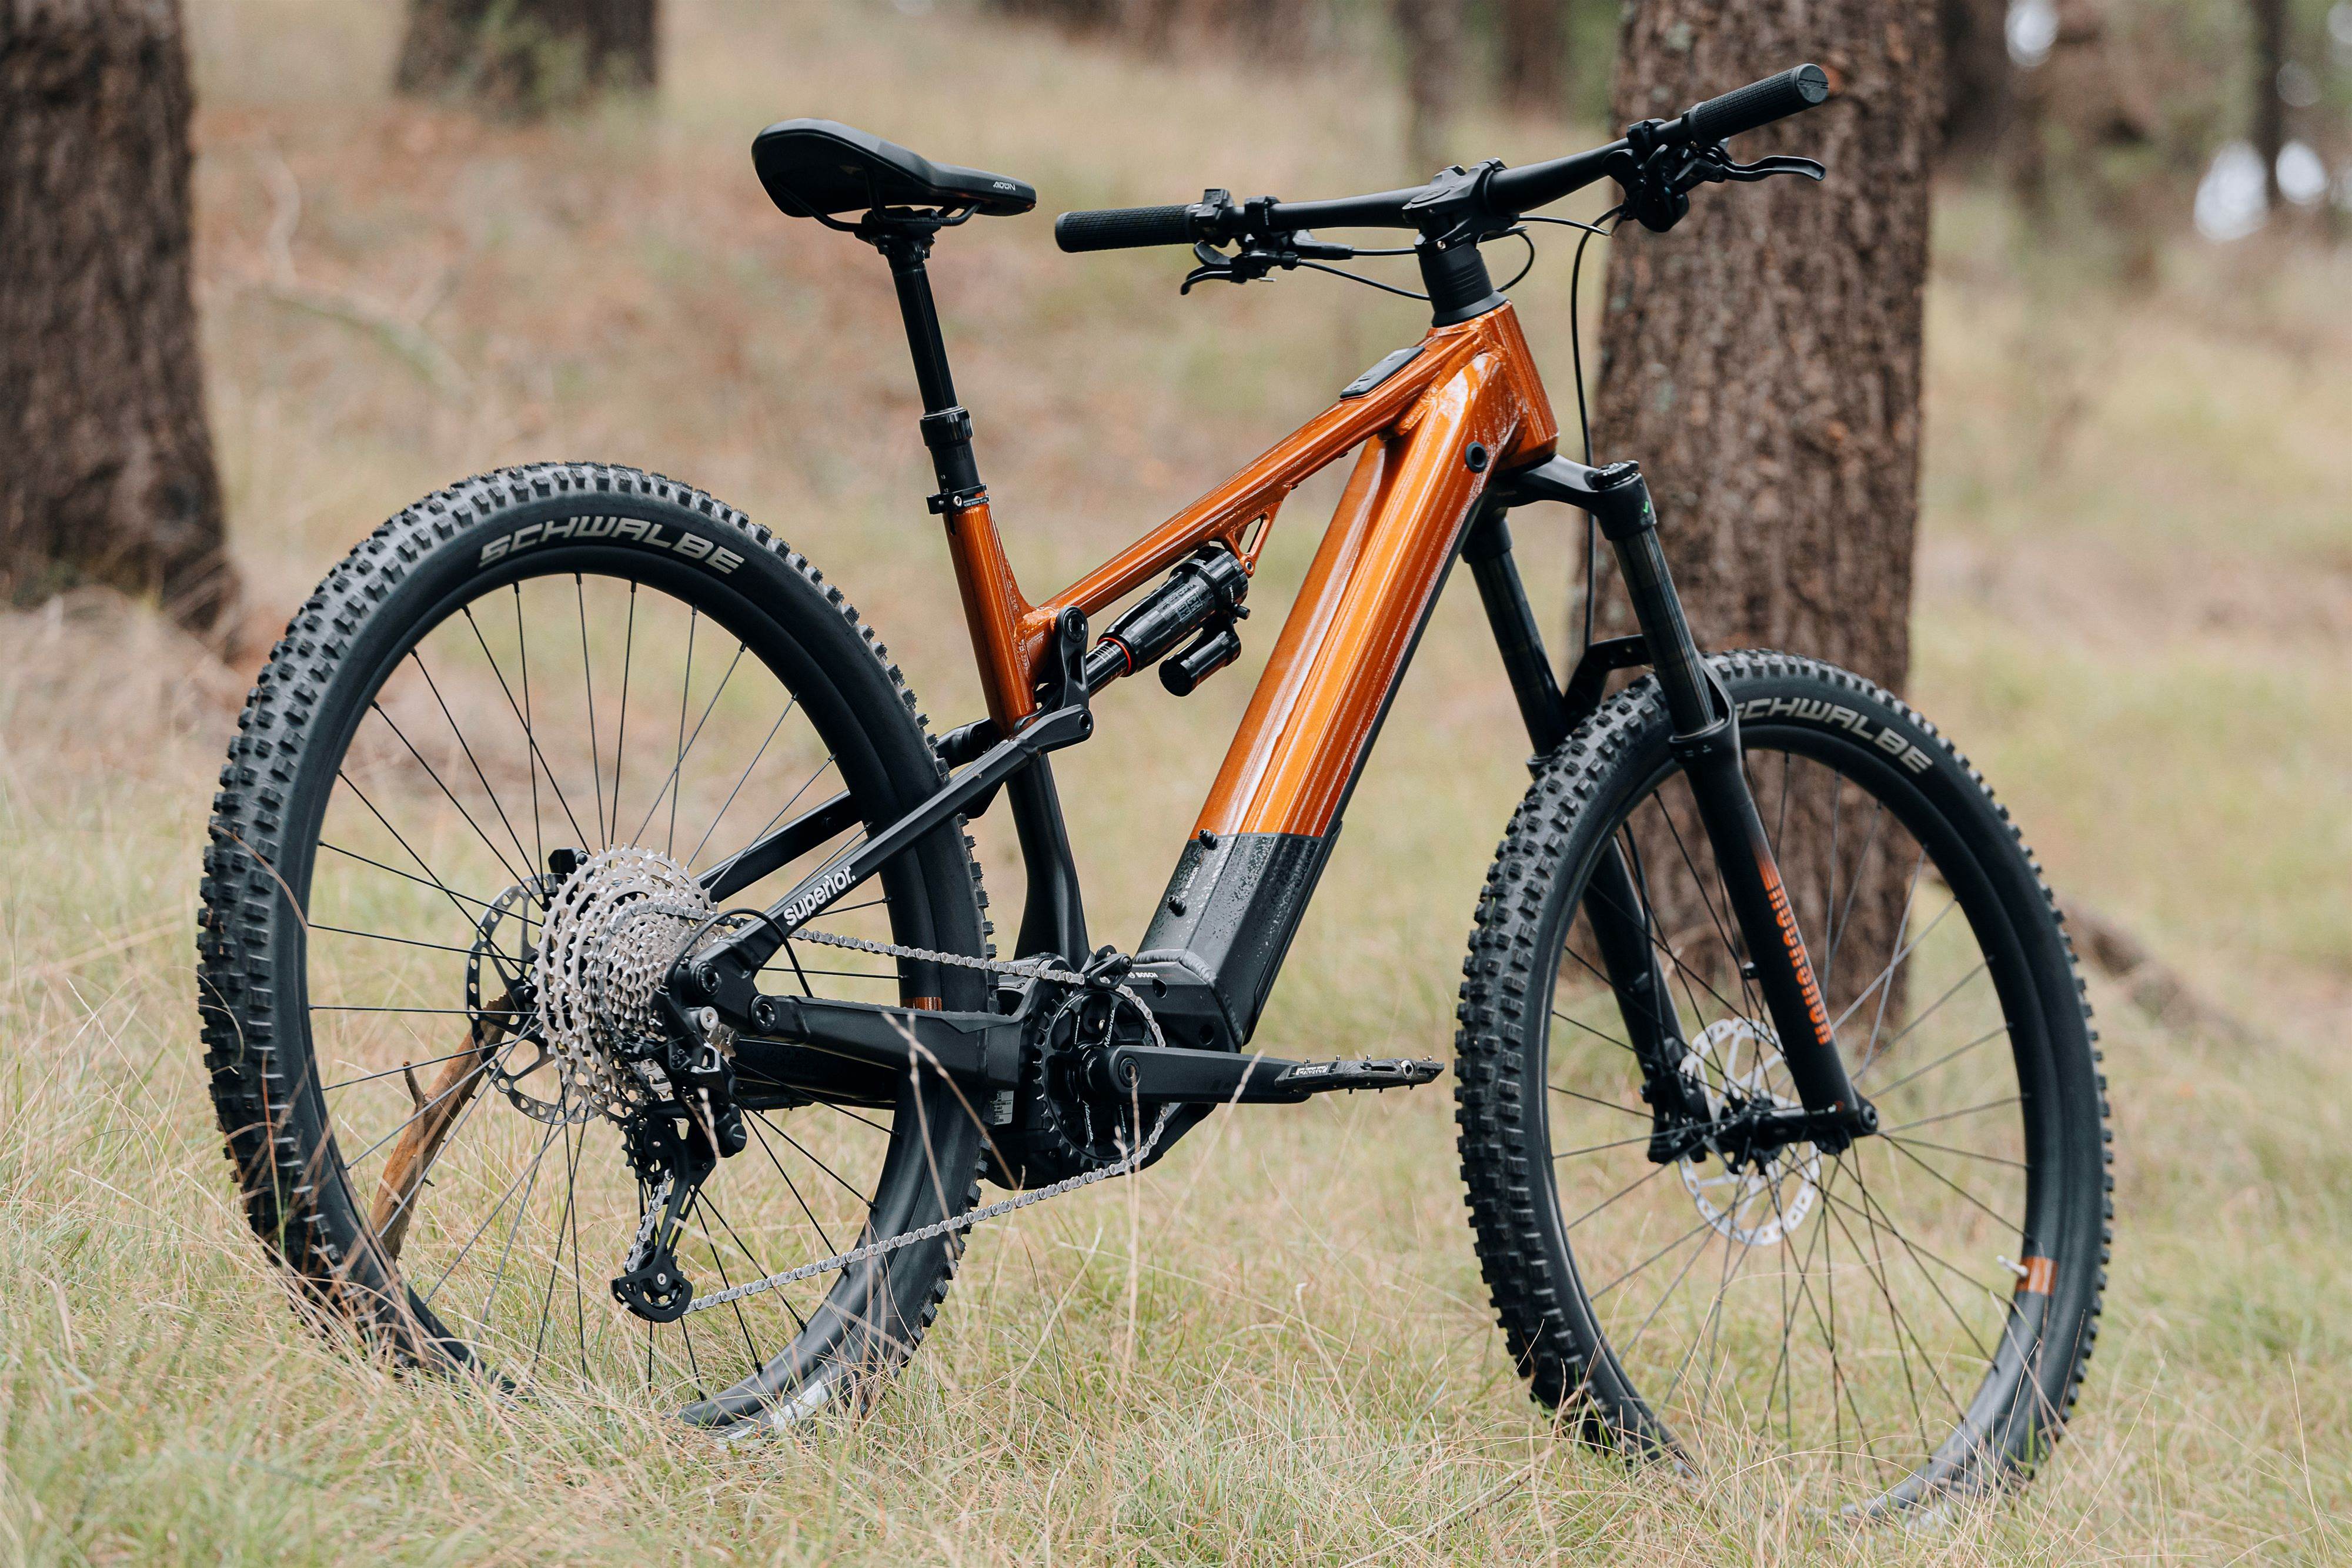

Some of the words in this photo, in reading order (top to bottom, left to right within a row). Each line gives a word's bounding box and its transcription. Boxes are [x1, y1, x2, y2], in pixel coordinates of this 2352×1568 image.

[993, 181, 1016, 191] AIDON
[478, 516, 745, 574] SCHWALBE
[1185, 867, 1200, 888] BOSCH
